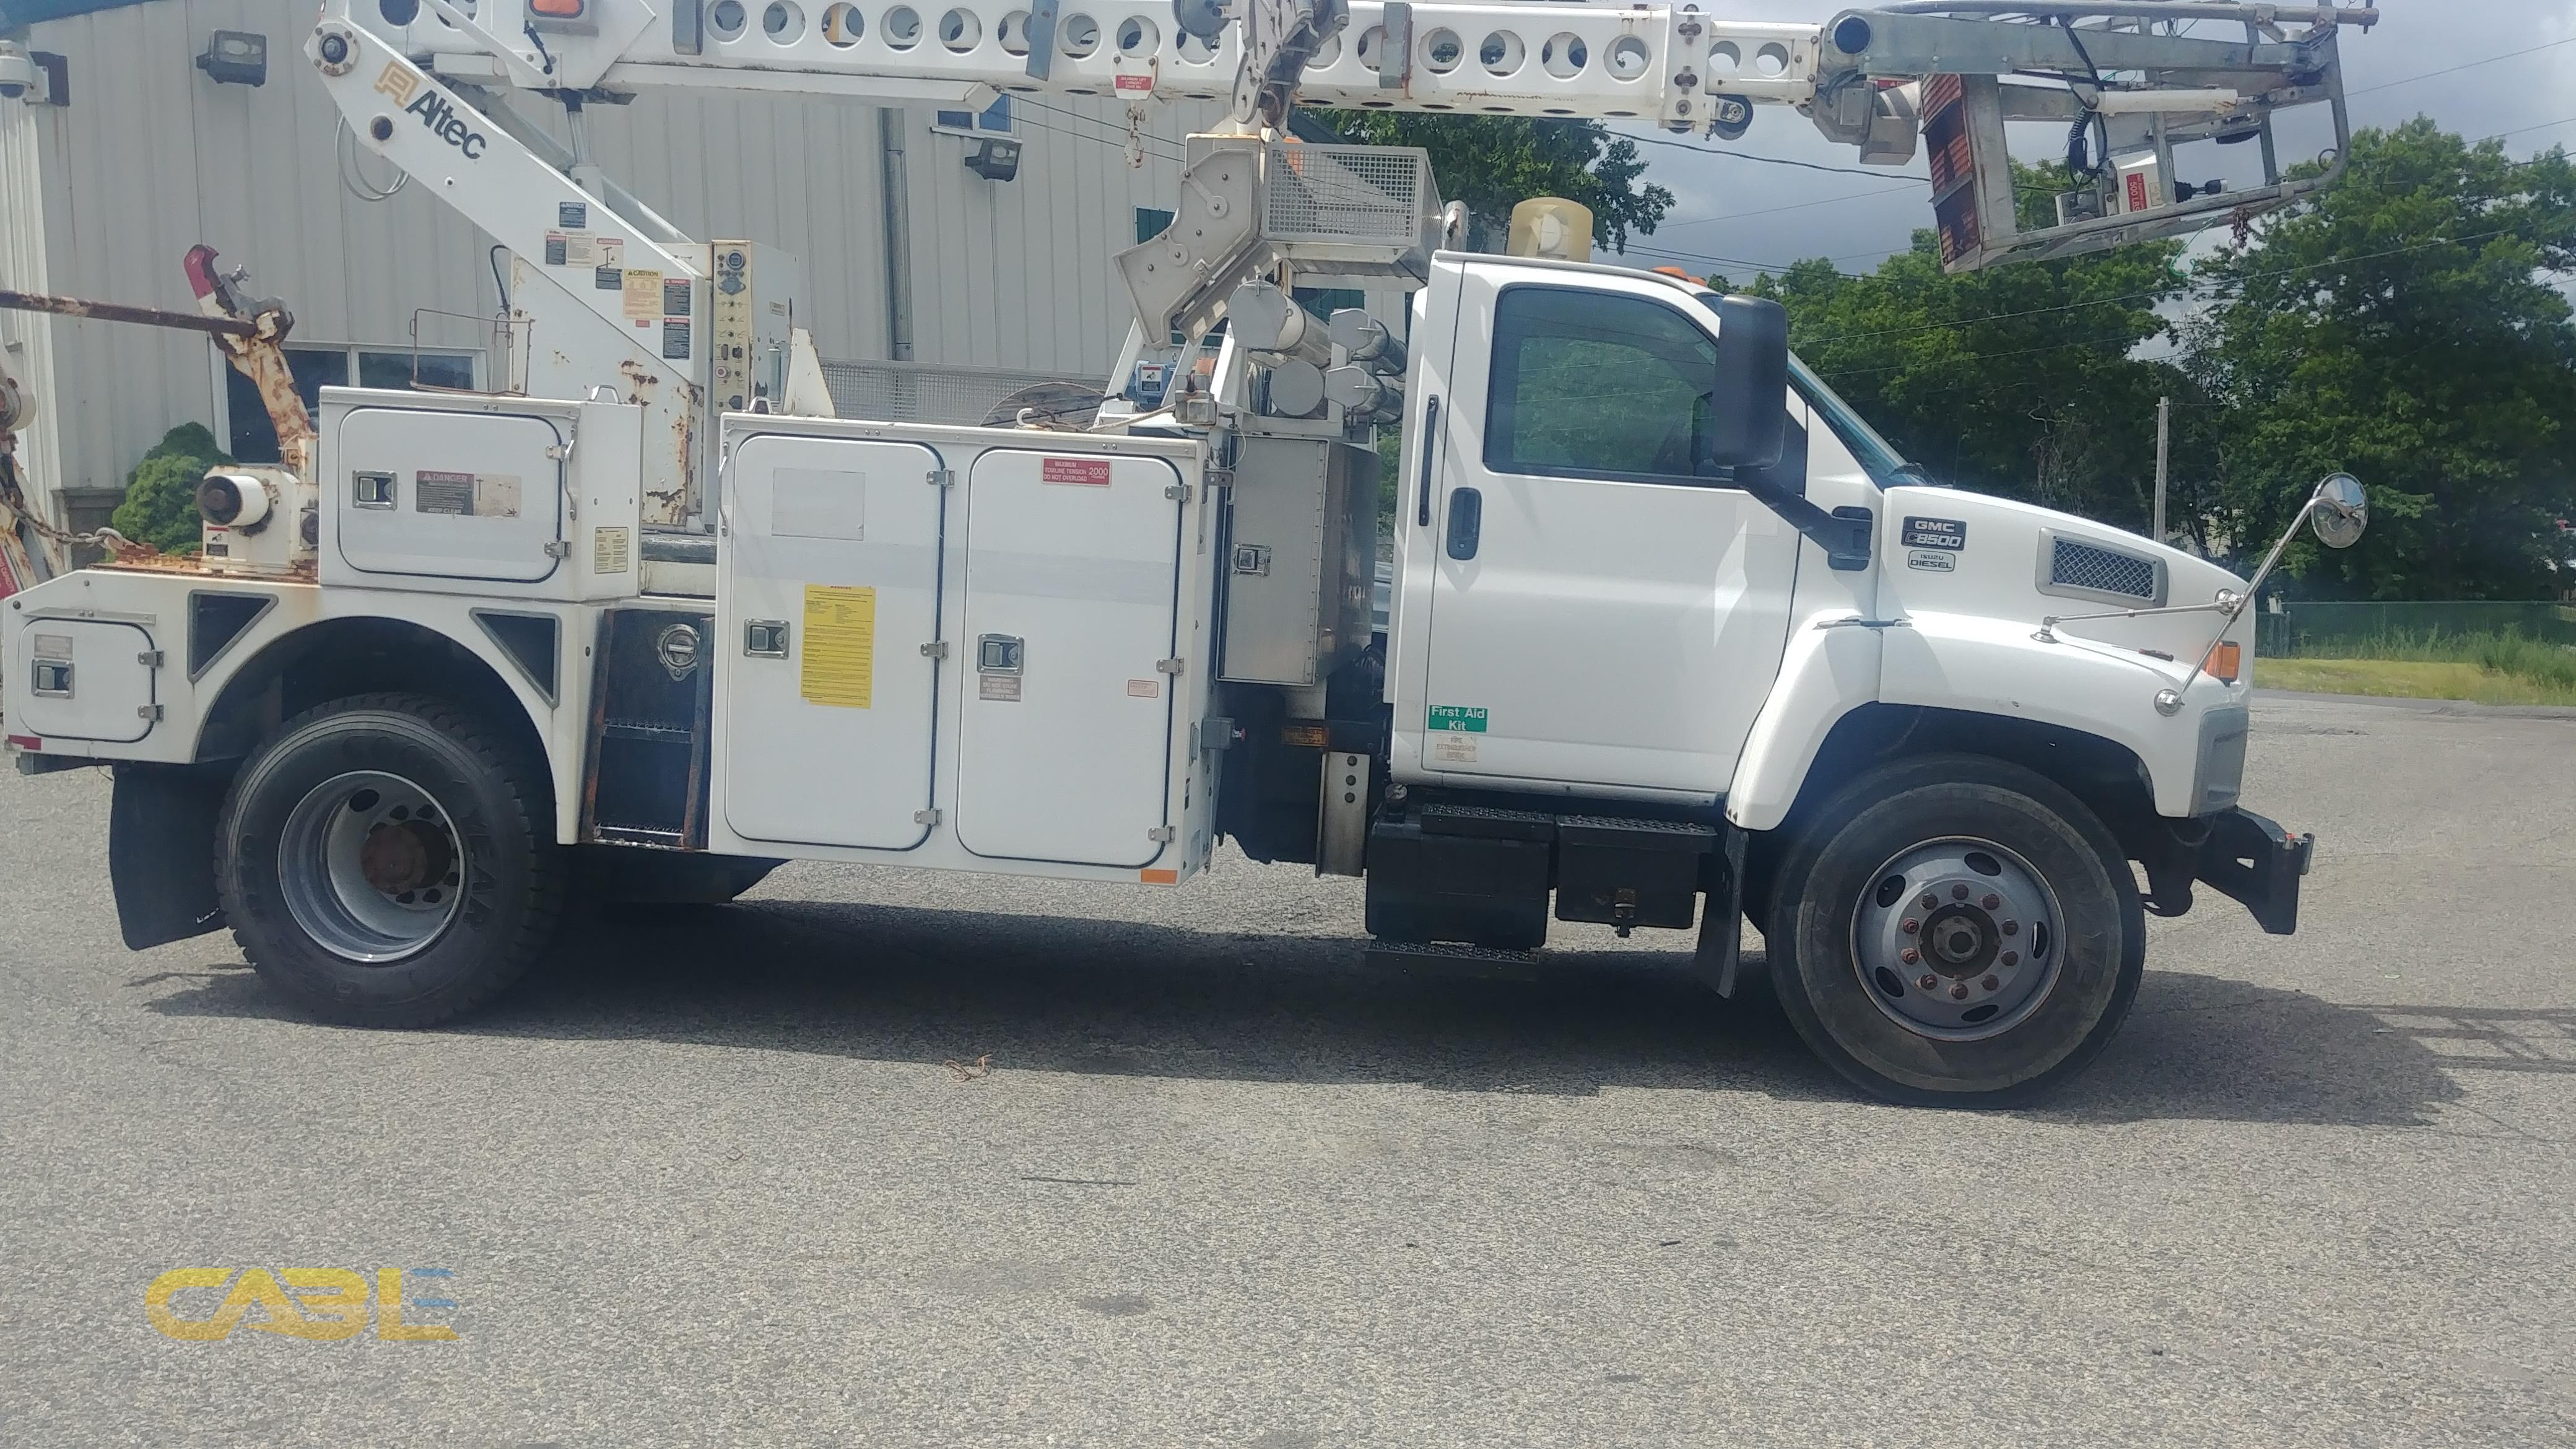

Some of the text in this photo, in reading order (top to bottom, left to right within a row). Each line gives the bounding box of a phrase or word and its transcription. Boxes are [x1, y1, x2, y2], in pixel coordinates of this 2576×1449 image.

[405, 89, 486, 159] Altec
[2130, 181, 2138, 196] 500
[433, 473, 467, 482] DANGER
[1089, 467, 1108, 476] 2000
[1915, 520, 1955, 533] GMC
[1905, 532, 1962, 547] C8500
[1910, 560, 1952, 569] DIESEL
[1431, 705, 1485, 719] First Aid
[1448, 720, 1466, 731] Kit
